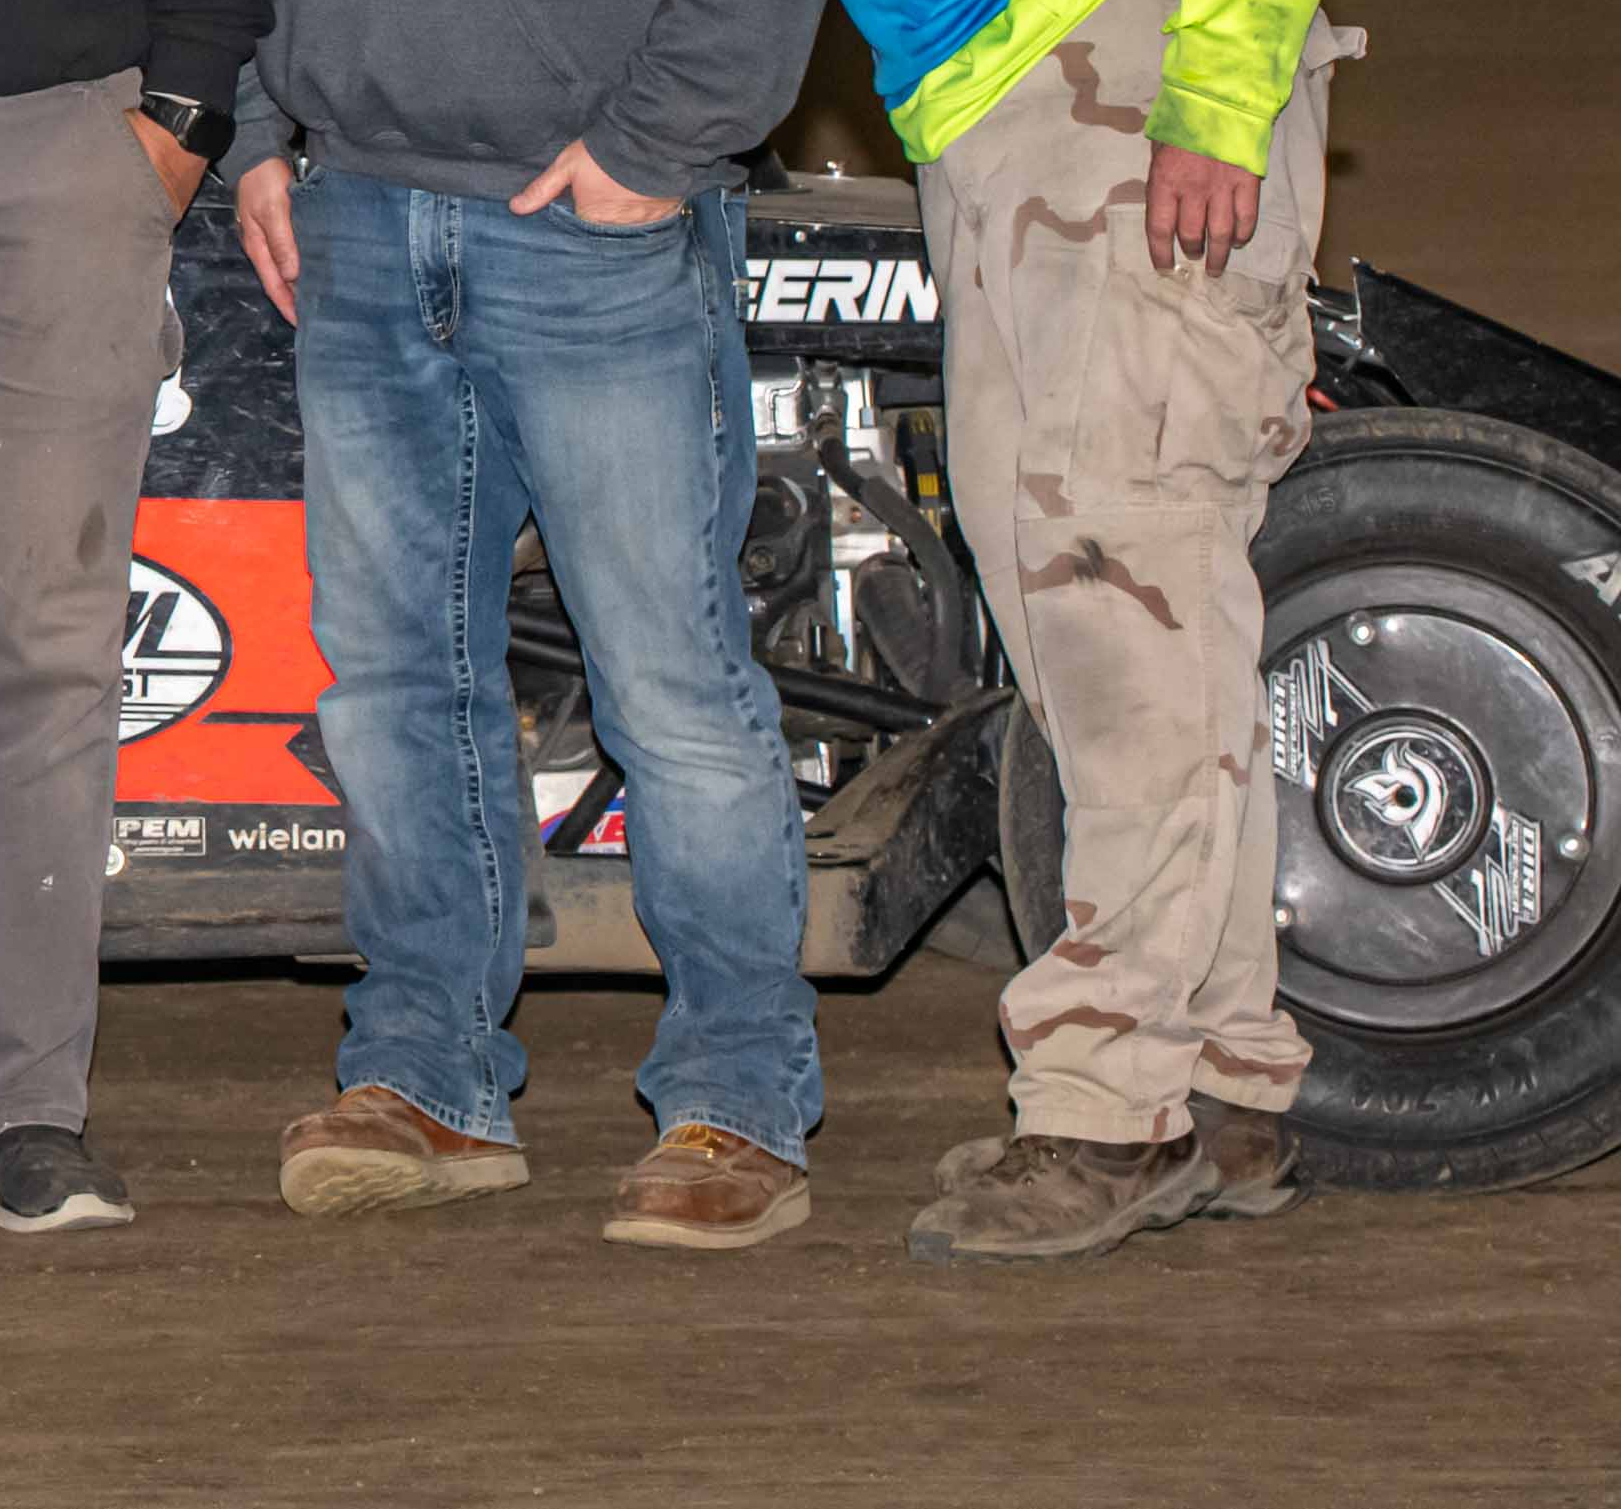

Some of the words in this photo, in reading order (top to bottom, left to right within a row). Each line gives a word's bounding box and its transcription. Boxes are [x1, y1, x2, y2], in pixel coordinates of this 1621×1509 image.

[1272, 675, 1287, 770] DIRT
[118, 819, 201, 838] PEM
[1522, 825, 1536, 916] DIRT
